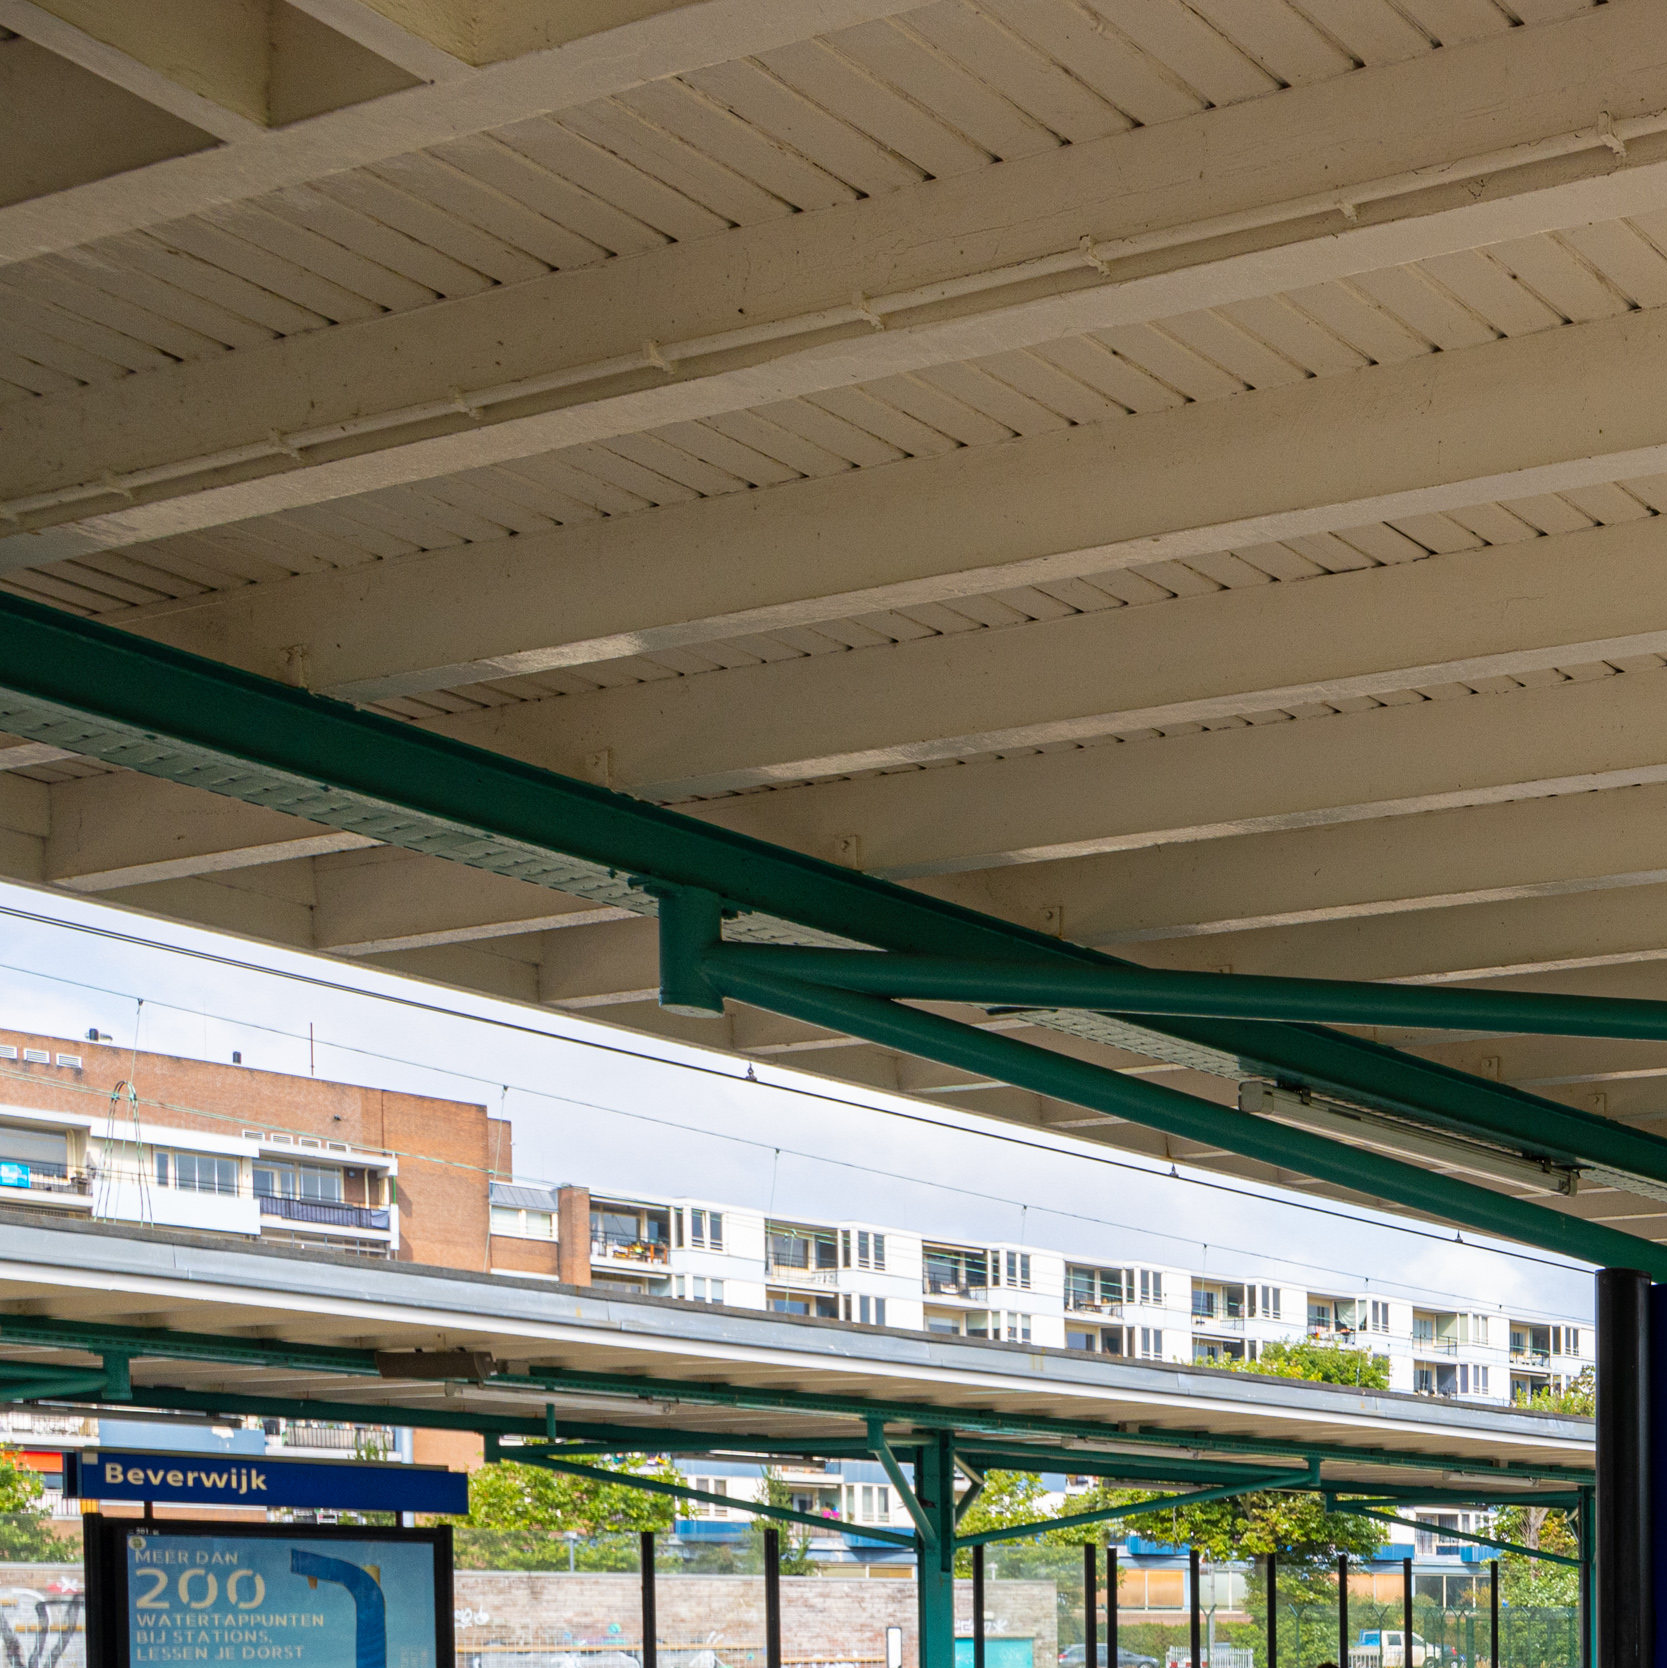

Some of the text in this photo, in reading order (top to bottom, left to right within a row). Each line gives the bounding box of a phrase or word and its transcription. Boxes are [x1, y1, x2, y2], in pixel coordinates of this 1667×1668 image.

[105, 1462, 268, 1495] Beverwijk
[135, 1550, 239, 1565] MEER DAN
[136, 1567, 266, 1610] 200
[136, 1613, 325, 1628] WATERTAPPUNTEN
[136, 1630, 167, 1645] BIJ
[136, 1645, 305, 1662] LESSEN JE DORST
